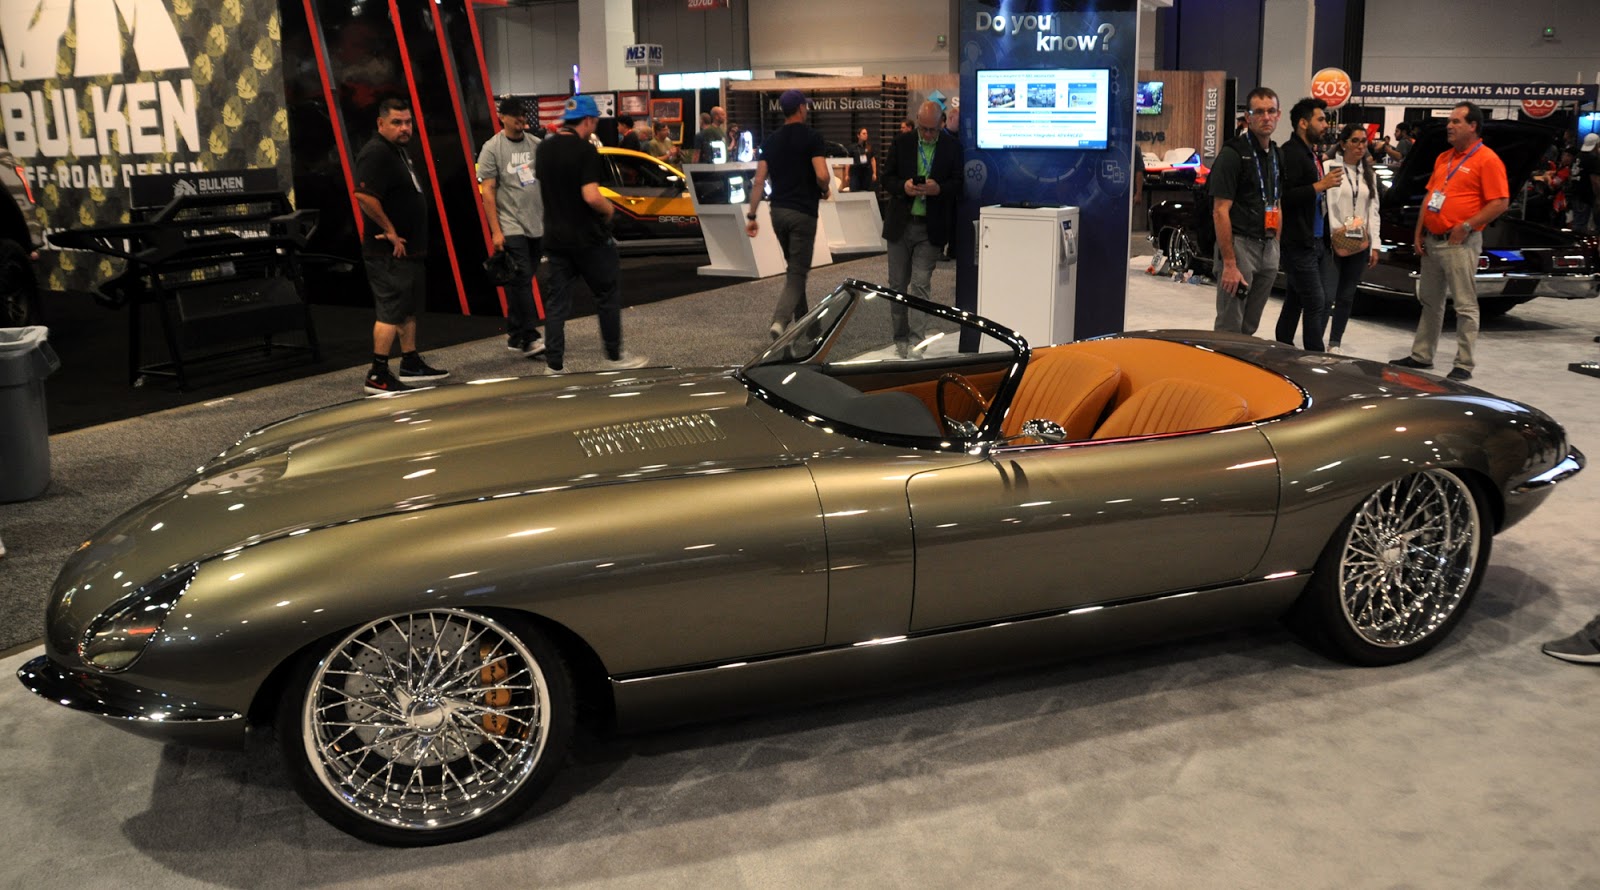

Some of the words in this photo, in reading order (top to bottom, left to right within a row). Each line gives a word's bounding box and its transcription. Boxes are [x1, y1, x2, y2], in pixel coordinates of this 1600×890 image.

[976, 12, 1006, 31] Do
[1012, 14, 1051, 35] you
[1314, 81, 1347, 97] 303
[1360, 84, 1409, 94] PREMIUM
[1413, 85, 1492, 95] PROTECTANTS
[1495, 86, 1520, 95] AND
[1524, 87, 1586, 96] CLEANERS
[813, 97, 836, 110] with
[1206, 88, 1217, 111] fast
[1, 79, 200, 158] BULKEN
[1204, 124, 1215, 157] Make
[511, 151, 531, 164] NIKE
[199, 177, 244, 191] BULKEN
